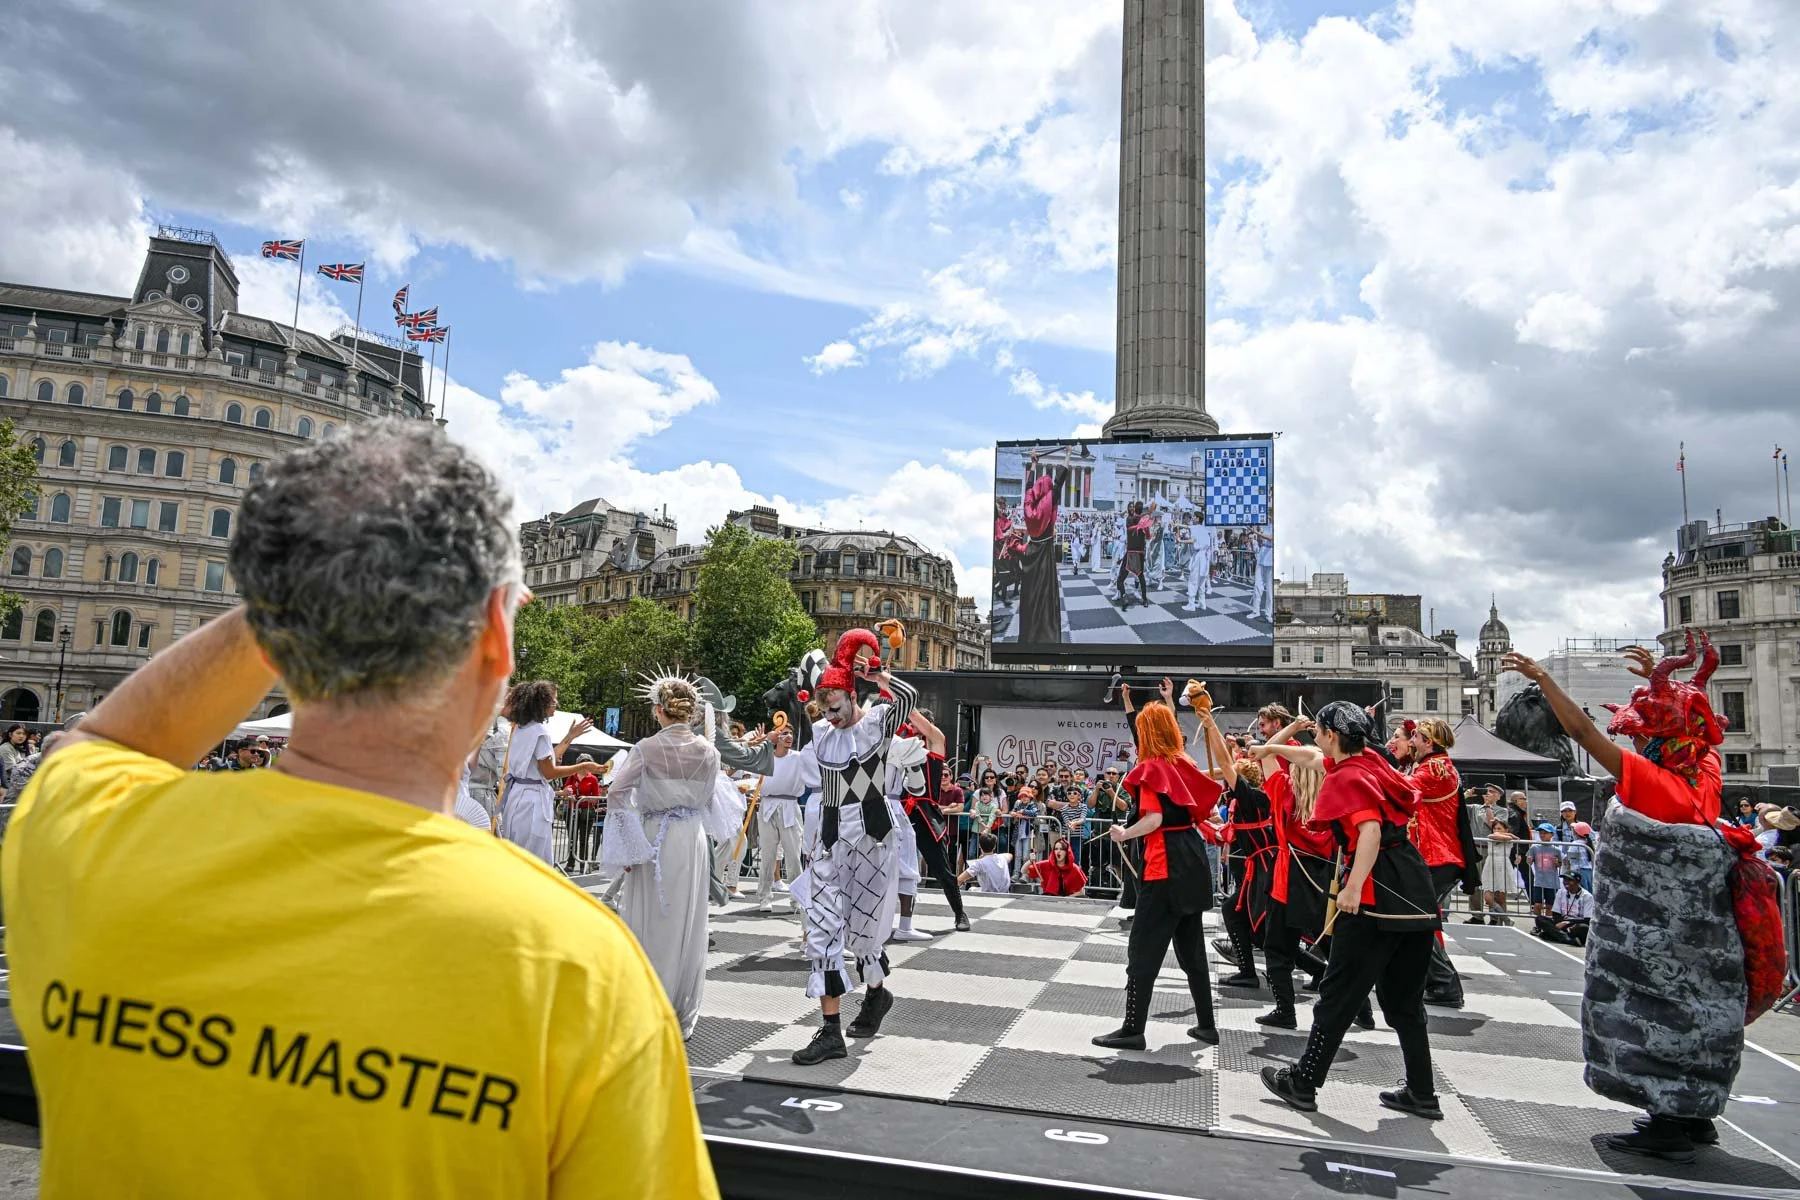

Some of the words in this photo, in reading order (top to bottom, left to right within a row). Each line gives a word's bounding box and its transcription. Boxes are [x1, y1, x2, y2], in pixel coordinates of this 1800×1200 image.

[1058, 721, 1108, 729] WELCOME
[41, 980, 235, 1068] CHESS
[250, 1026, 520, 1131] MASTER
[780, 1097, 843, 1111] 5
[1044, 1128, 1109, 1144] 6
